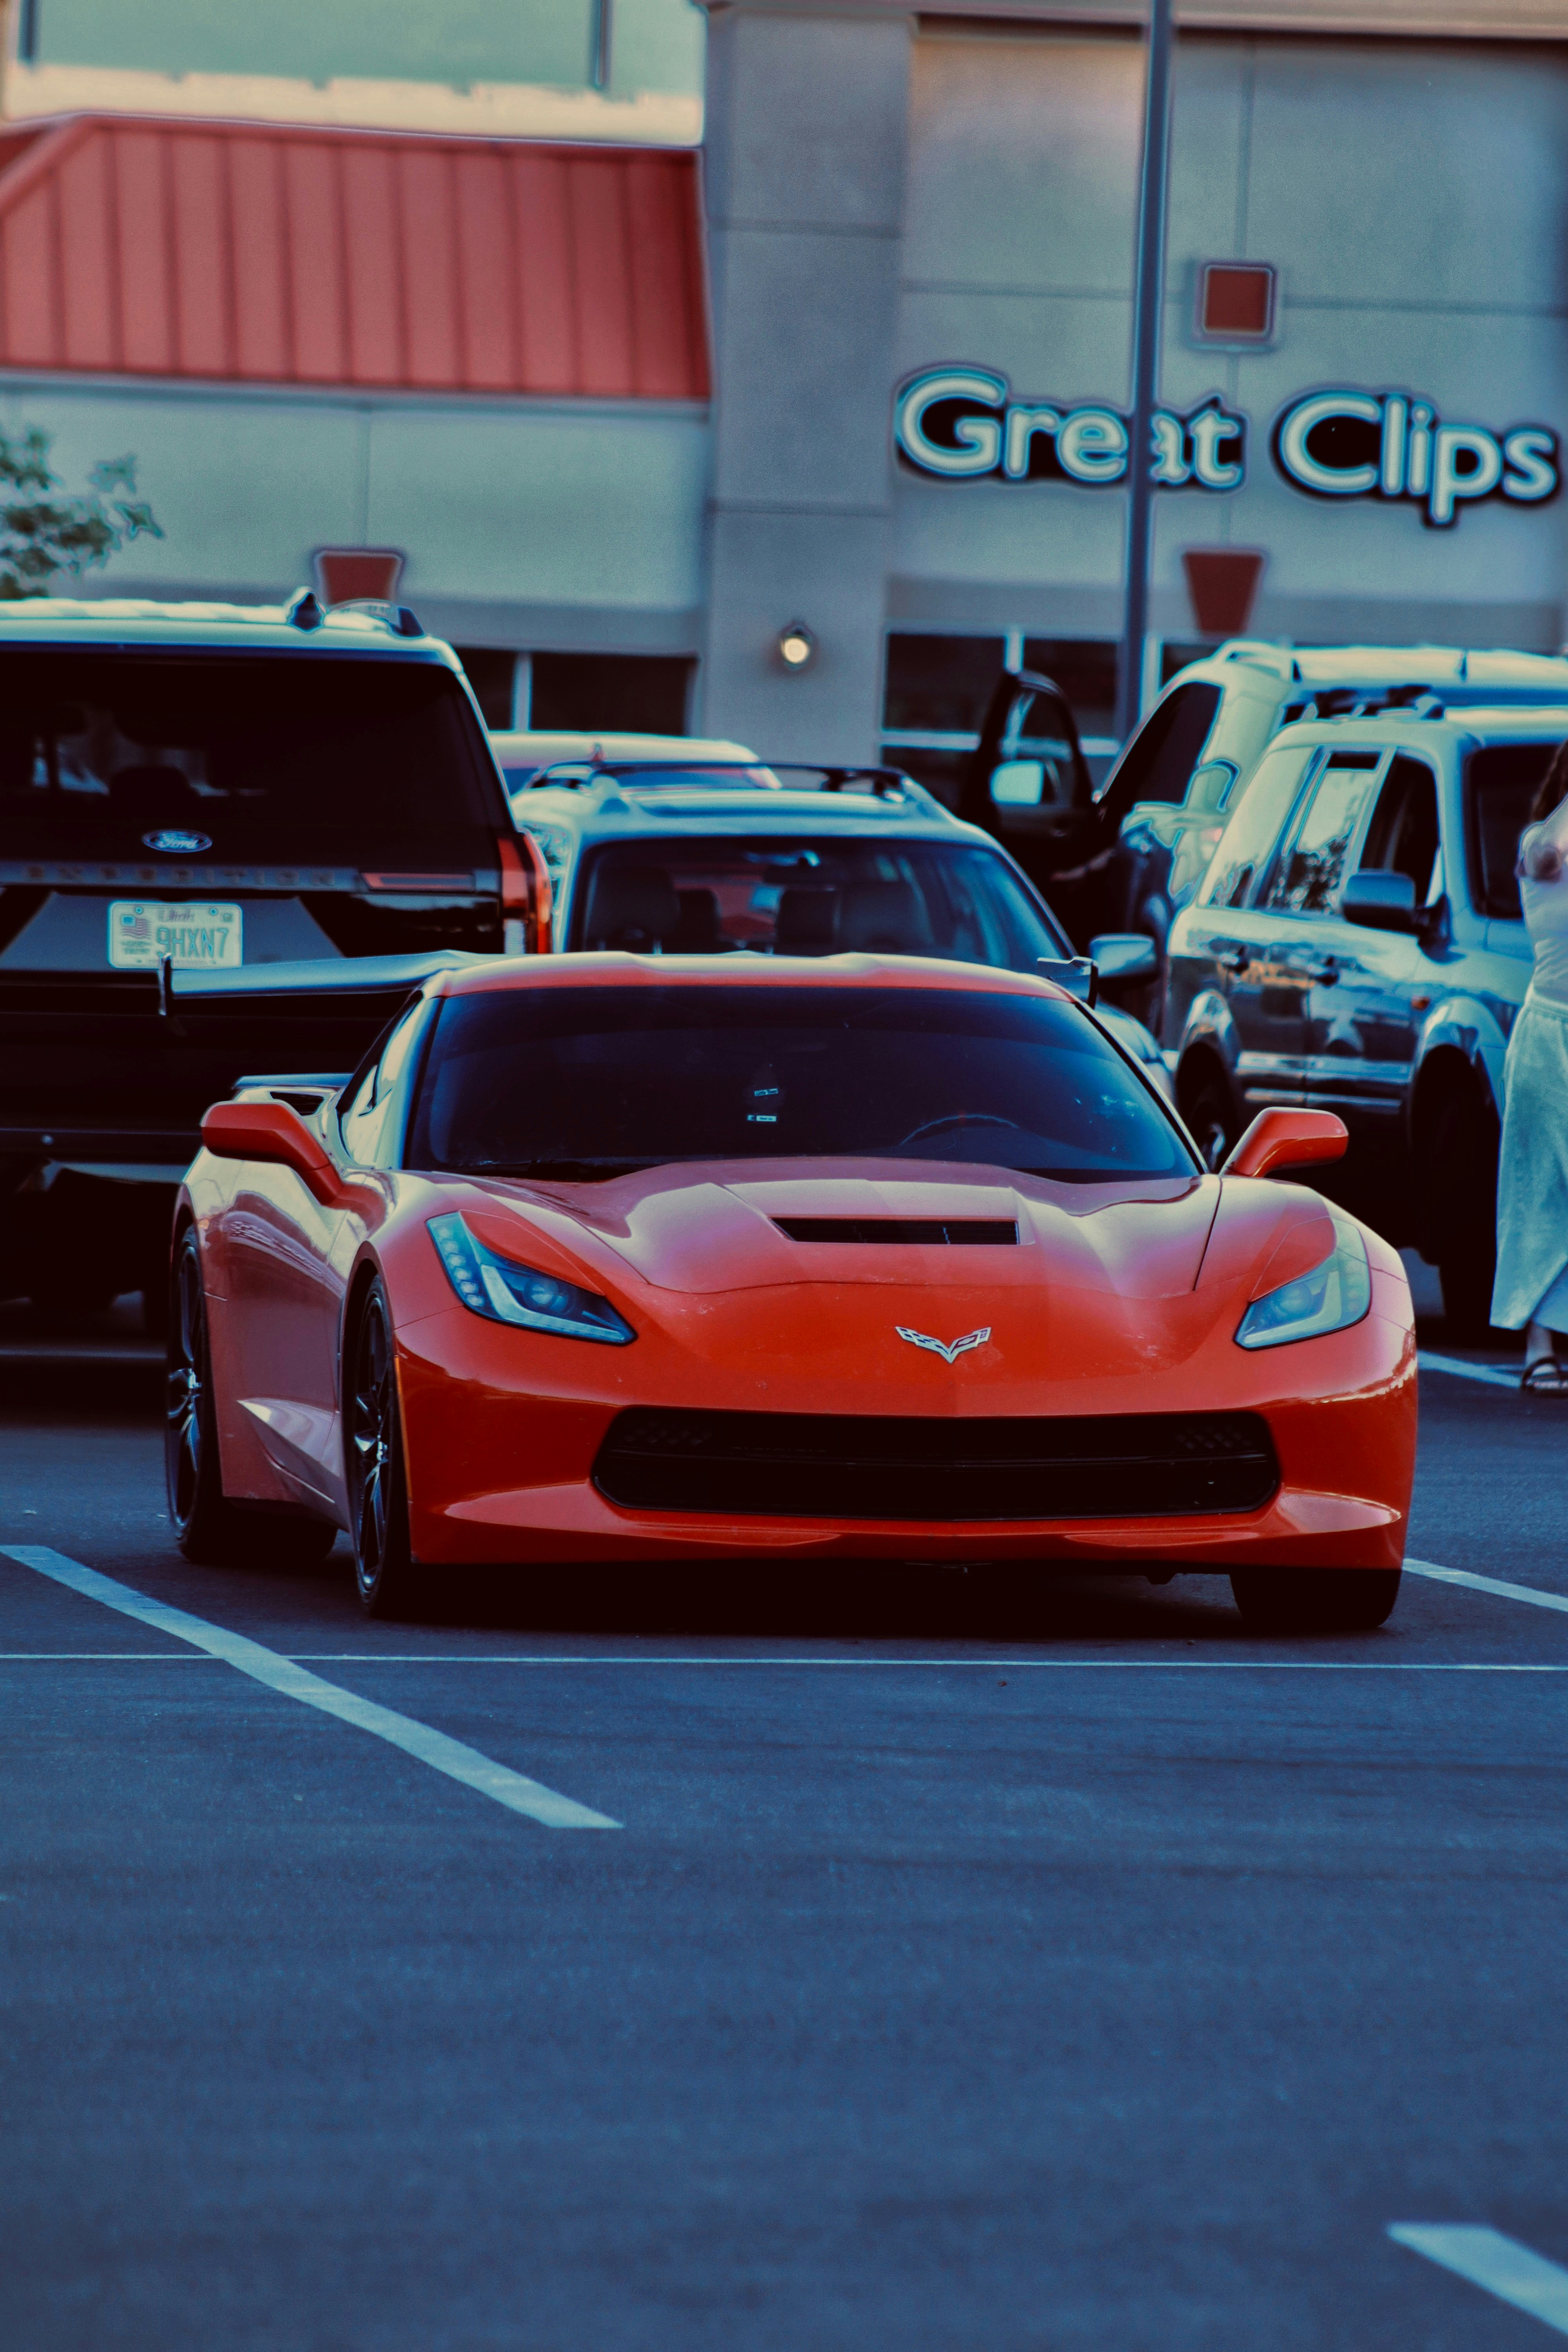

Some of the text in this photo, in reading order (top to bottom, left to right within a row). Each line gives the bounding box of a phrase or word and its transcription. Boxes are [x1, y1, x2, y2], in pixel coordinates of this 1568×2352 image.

[898, 373, 1557, 524] Great Clips
[156, 927, 229, 958] 9HXN7
